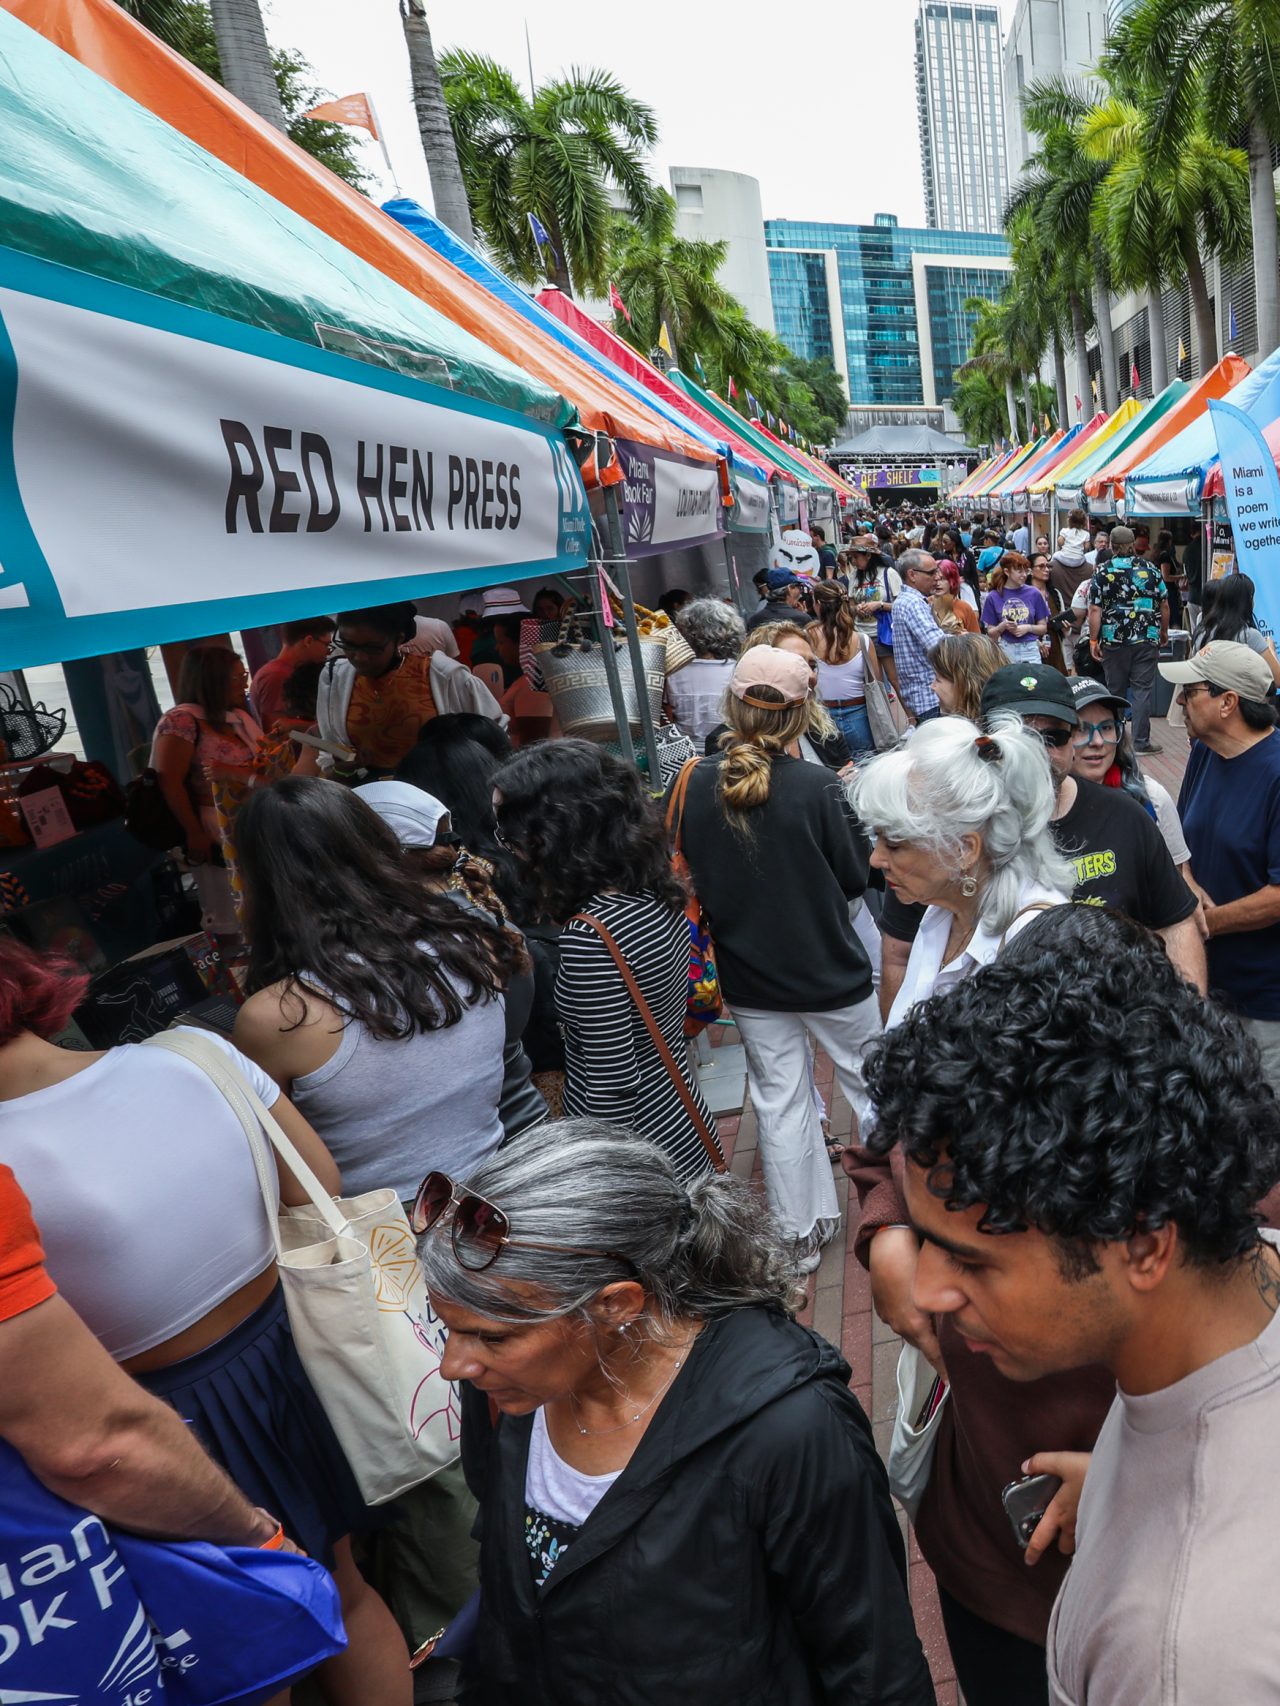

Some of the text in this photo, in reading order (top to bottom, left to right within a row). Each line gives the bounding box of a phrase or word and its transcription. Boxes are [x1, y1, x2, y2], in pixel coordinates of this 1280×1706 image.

[628, 456, 649, 479] Miami
[1232, 465, 1264, 479] Miami
[220, 419, 522, 534] RED HEN PRESS
[886, 470, 913, 485] SHELF
[624, 481, 653, 504] Book Fair
[1235, 486, 1253, 497] is a
[1237, 502, 1269, 517] poem
[1239, 521, 1256, 532] we
[1072, 850, 1116, 884] TERS
